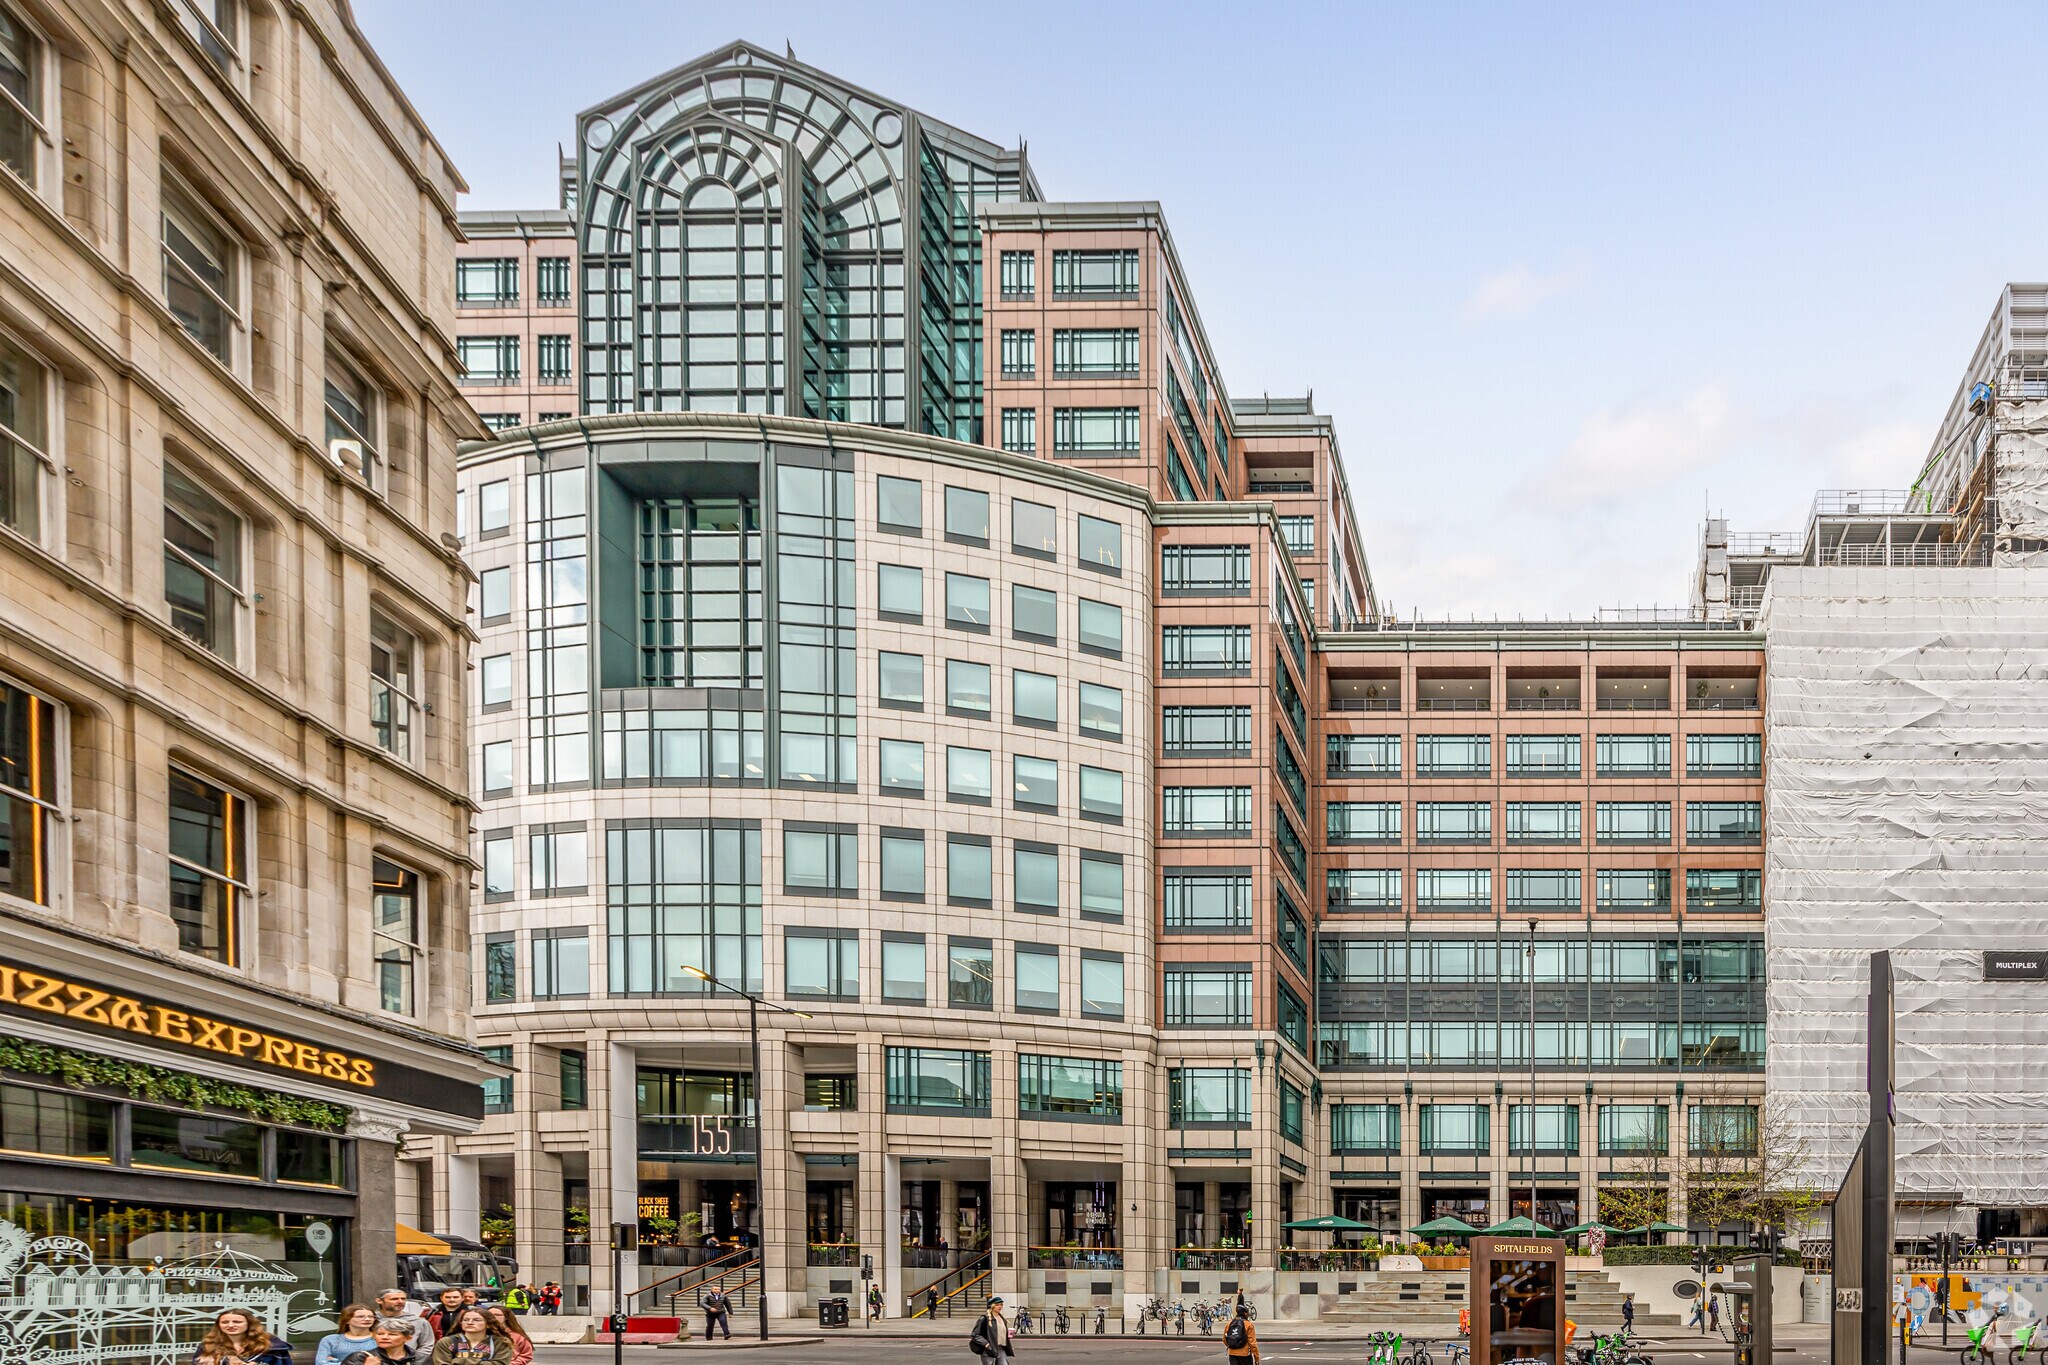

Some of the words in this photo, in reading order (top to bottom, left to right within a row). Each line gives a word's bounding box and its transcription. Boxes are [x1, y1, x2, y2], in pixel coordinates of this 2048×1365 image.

[690, 1115, 730, 1154] 155
[638, 1205, 669, 1218] COFFEE
[1494, 1244, 1553, 1254] SPITALFIELDS
[164, 1268, 224, 1278] PIZZERIA
[1837, 1291, 1861, 1310] 250
